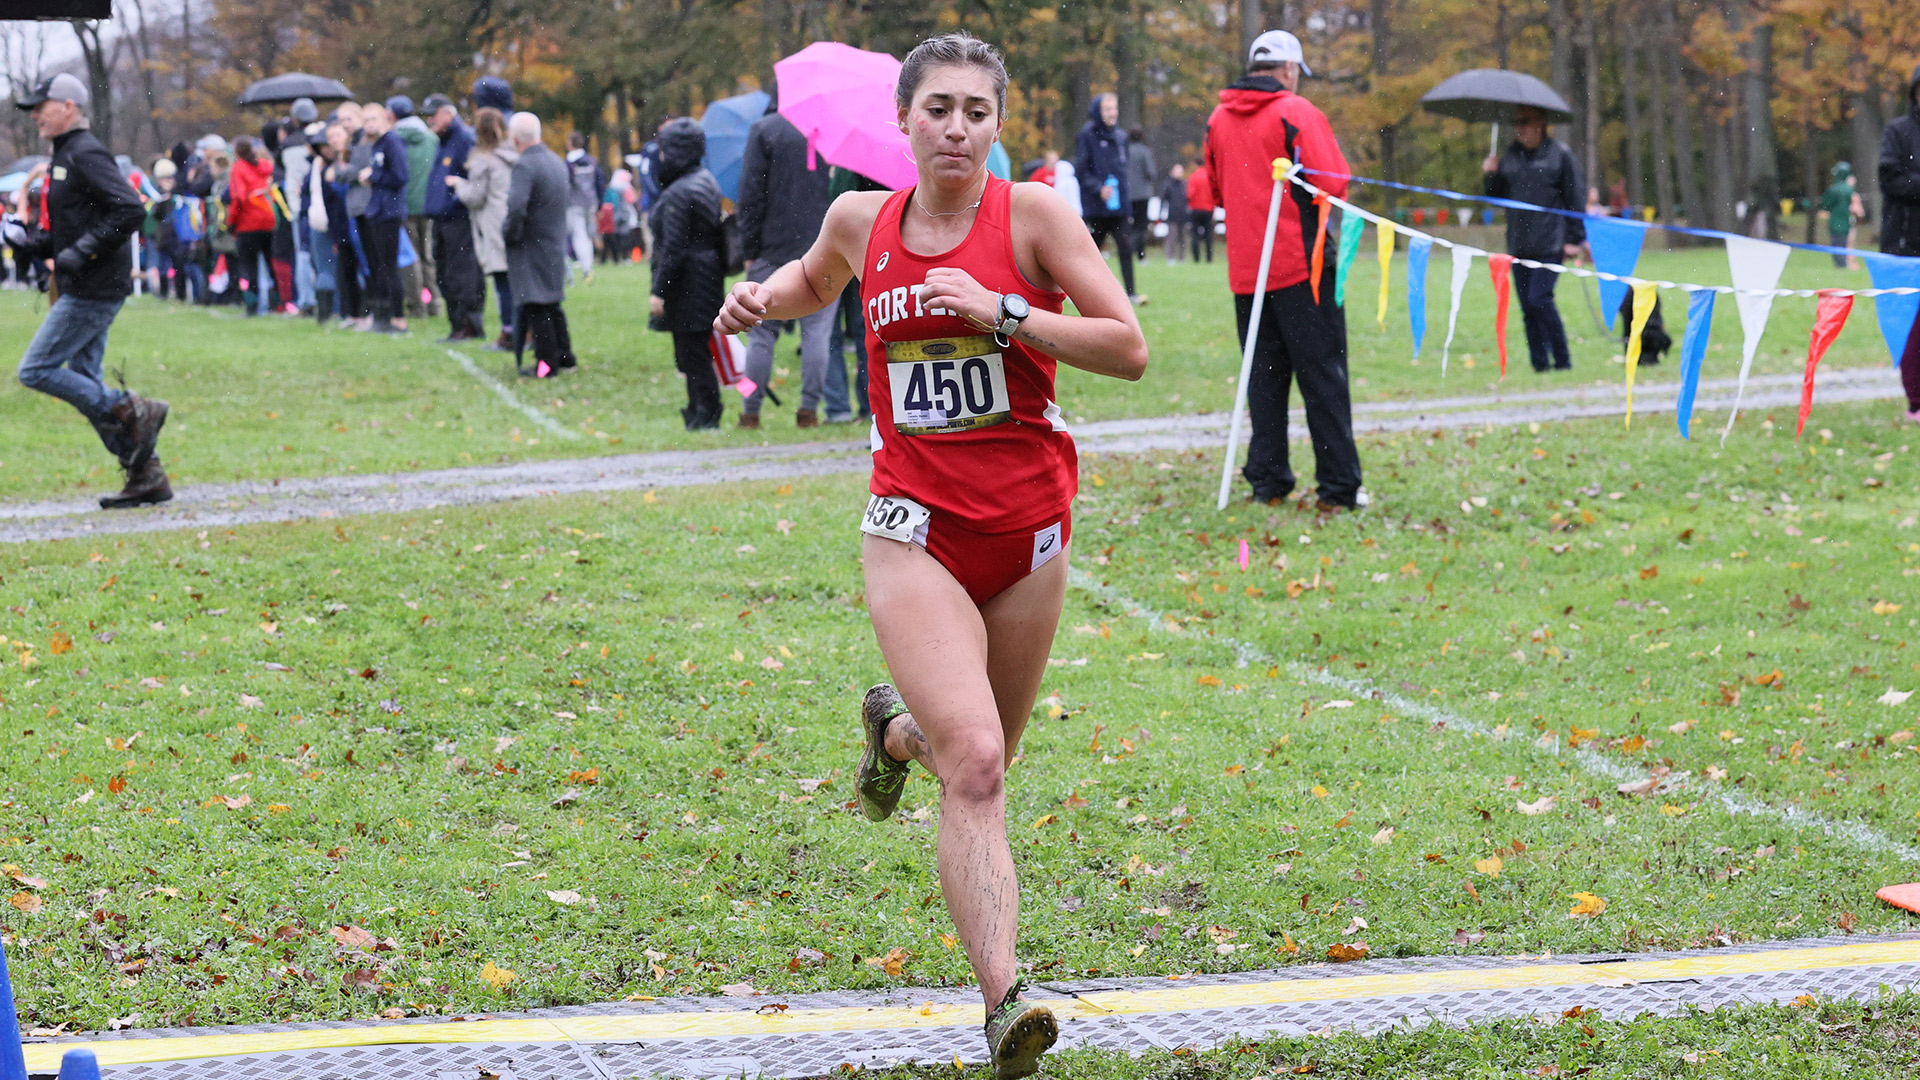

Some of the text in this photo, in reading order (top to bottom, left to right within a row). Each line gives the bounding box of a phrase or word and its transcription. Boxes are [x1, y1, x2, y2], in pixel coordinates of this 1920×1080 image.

[868, 284, 960, 332] CORT
[904, 358, 994, 419] 450
[867, 496, 909, 530] 450
